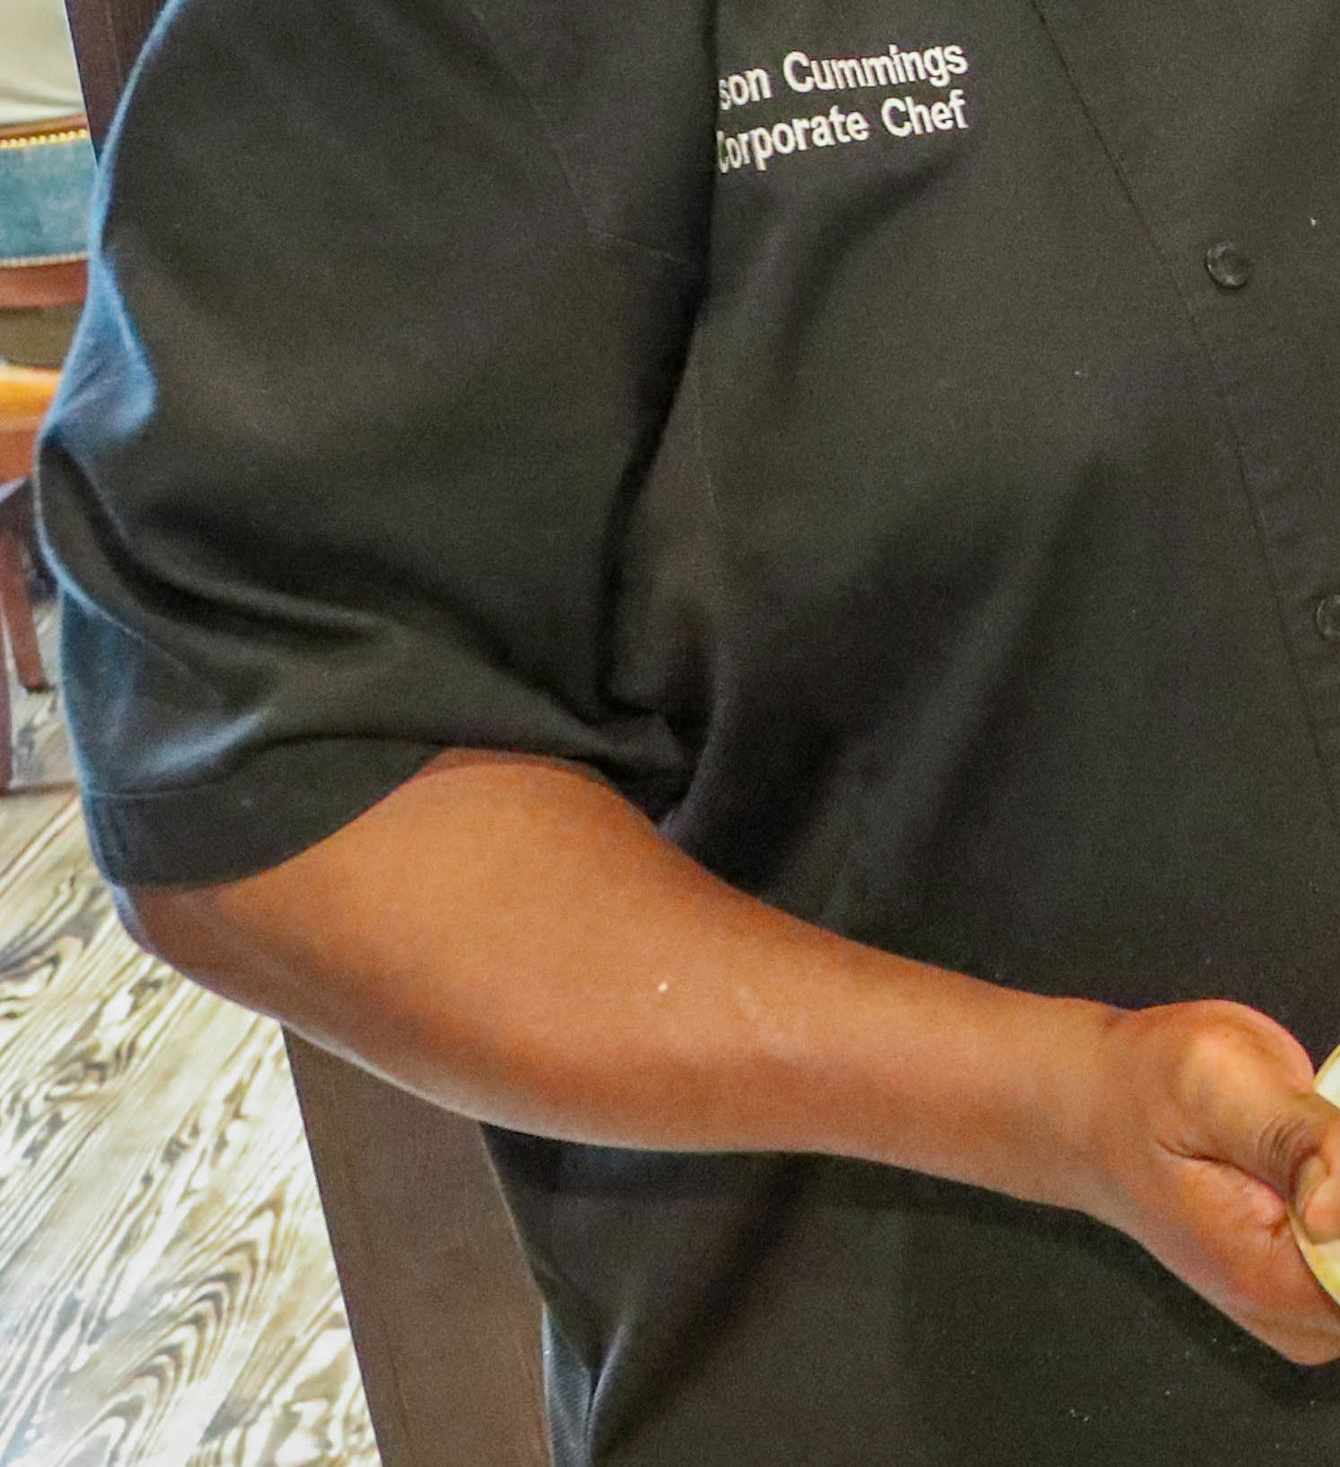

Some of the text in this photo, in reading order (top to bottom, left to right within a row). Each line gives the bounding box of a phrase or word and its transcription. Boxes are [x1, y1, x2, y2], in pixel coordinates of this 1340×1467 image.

[783, 44, 969, 94] Cummings
[716, 89, 969, 173] Corporate Chef
